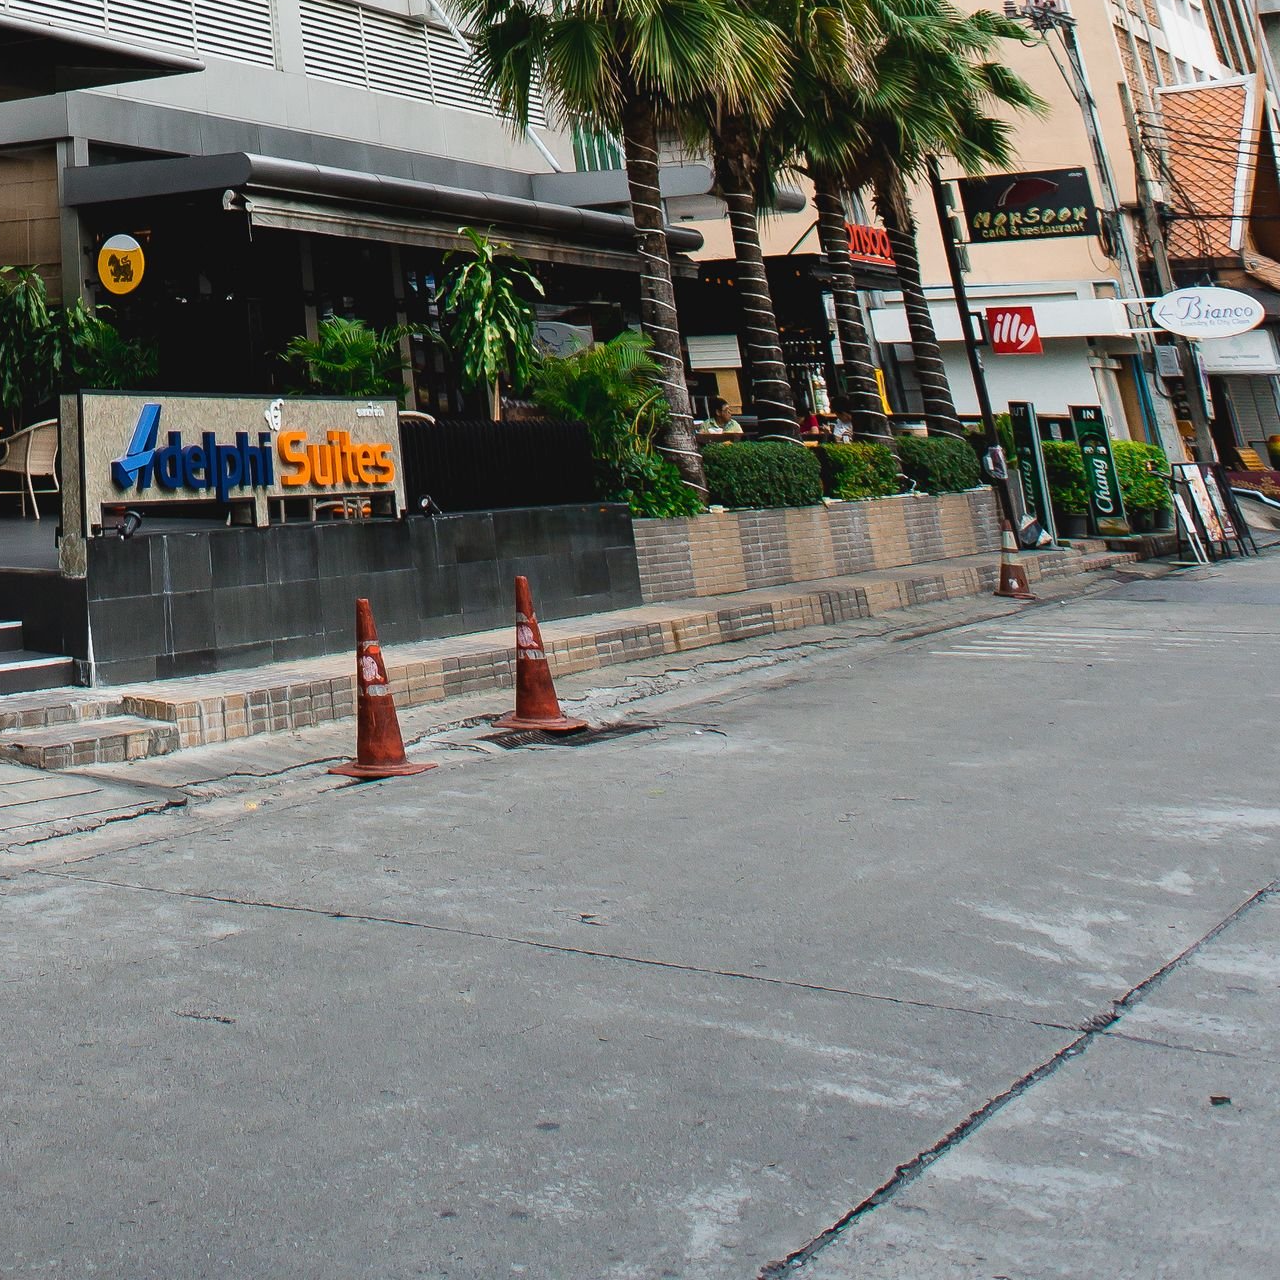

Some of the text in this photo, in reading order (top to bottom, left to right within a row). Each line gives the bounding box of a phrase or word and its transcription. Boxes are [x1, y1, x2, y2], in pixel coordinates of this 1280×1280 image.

[1176, 296, 1253, 320] Bianco
[993, 312, 1035, 350] illy
[1082, 409, 1095, 420] IN
[110, 403, 395, 503] Adelphi Suites
[1092, 458, 1114, 514] Chang
